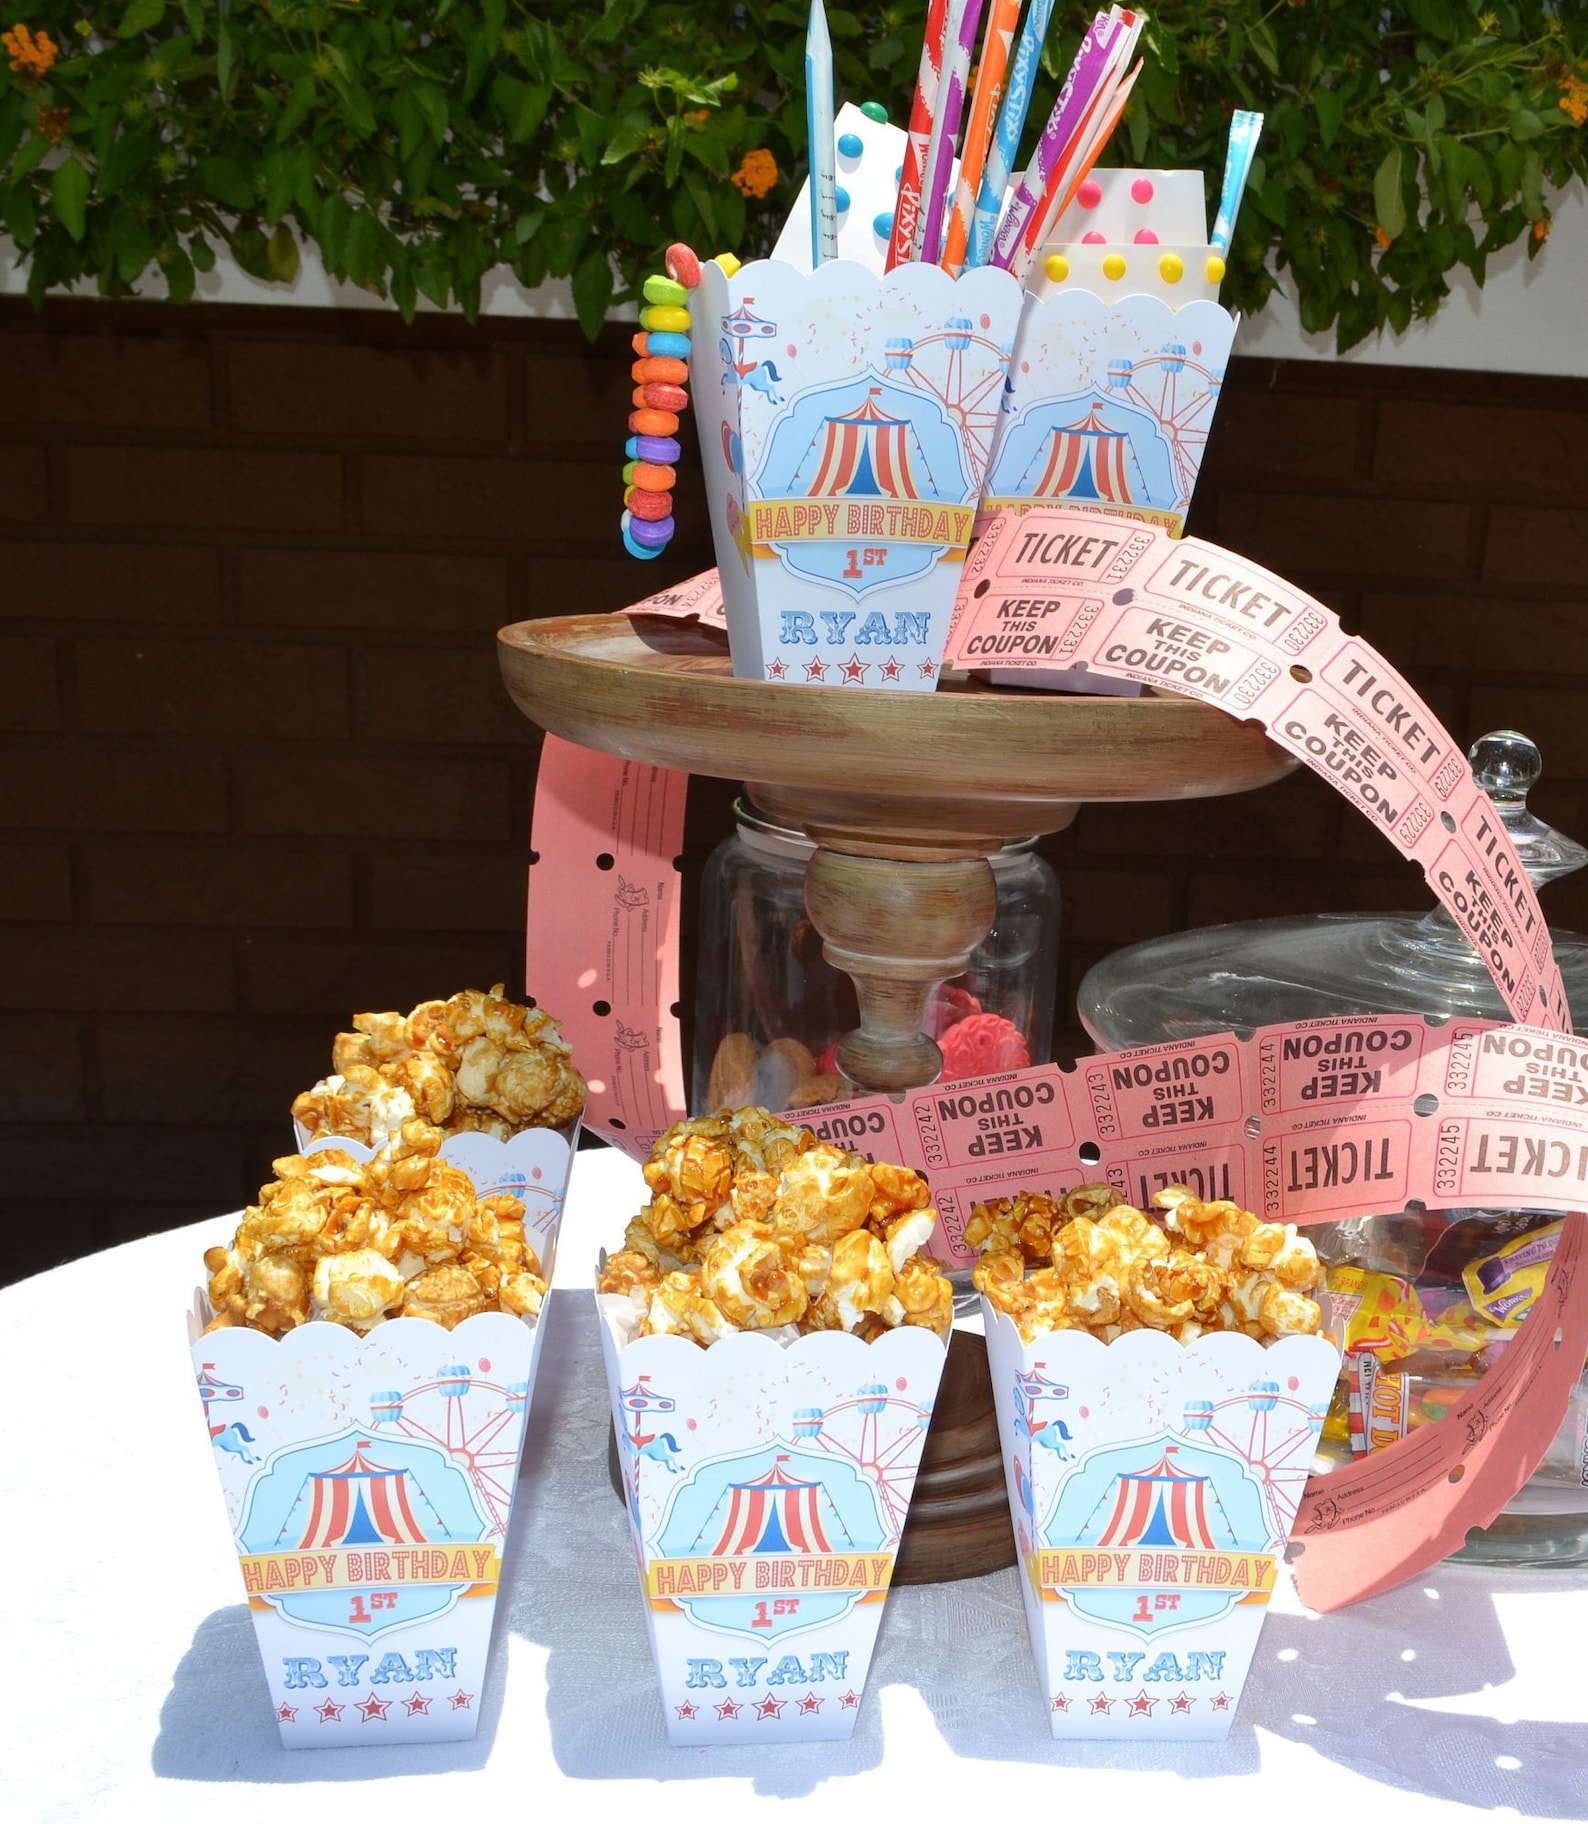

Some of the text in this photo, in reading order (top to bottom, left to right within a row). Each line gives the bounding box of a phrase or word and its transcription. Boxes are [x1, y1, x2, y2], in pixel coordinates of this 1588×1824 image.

[755, 504, 839, 539] HAPPY
[847, 504, 970, 541] BIRTHDAY
[842, 548, 888, 578] 1ST
[971, 523, 1003, 573] 332232
[1015, 533, 1119, 569] TICKET
[1106, 536, 1150, 580] 332231
[997, 600, 1061, 618] KEEP
[1169, 559, 1292, 628] TICKET
[779, 610, 931, 645] RYAN
[1002, 621, 1037, 632] THIS
[1059, 605, 1099, 654] 332231
[1146, 618, 1231, 654] KEEP
[1284, 612, 1324, 651] 332230
[967, 635, 1059, 654] COUPON
[1154, 640, 1201, 661] THIS
[1105, 644, 1230, 694] COUPON
[1233, 661, 1277, 704] 332230
[1342, 658, 1441, 765] TICKET
[1323, 713, 1398, 781] KEEP
[1332, 737, 1374, 779] THIS
[1284, 721, 1398, 824] COUPON
[1306, 757, 1339, 786] INDIANA
[1339, 786, 1367, 810] TICKET
[1434, 757, 1462, 798] 332229
[1399, 802, 1431, 844] 332229
[1476, 815, 1536, 934] TICKET
[1466, 869, 1513, 949] KEEP
[1472, 895, 1499, 945] THIS
[1439, 871, 1516, 994] COUPON
[1309, 1019, 1340, 1028] TICKET
[1341, 1017, 1378, 1025] INDIANA
[1133, 1046, 1162, 1057] TICKET
[1162, 1040, 1196, 1052] INDIANA
[1283, 1030, 1412, 1061] COUPON
[1483, 1034, 1588, 1072] UPON
[1552, 1033, 1588, 1046] NDIANA
[1112, 1050, 1230, 1090] COUPON
[1261, 1043, 1276, 1108] 332244
[1318, 1056, 1367, 1073] THIS
[1447, 1032, 1473, 1090] 332245
[1526, 1062, 1582, 1083] THIS
[959, 1079, 986, 1089] TICKET
[986, 1072, 1018, 1084] INDIANA
[1153, 1082, 1199, 1101] THIS
[1301, 1070, 1382, 1100] KEEP
[797, 1108, 821, 1118] TICKET
[821, 1104, 851, 1113] INDIANA
[938, 1082, 1055, 1122] COUPON
[1088, 1073, 1116, 1134] 332243
[1142, 1096, 1214, 1128] KEEP
[1503, 1111, 1538, 1121] TICKET
[801, 1112, 885, 1141] COUP
[915, 1104, 943, 1164] 332242
[977, 1112, 1025, 1131] THIS
[1304, 1119, 1332, 1129] TICKET
[1332, 1114, 1367, 1124] INDIANA
[1541, 1116, 1584, 1128] INDIANA
[968, 1124, 1044, 1157] KEEP
[1151, 1146, 1176, 1156] TICKET
[1178, 1141, 1208, 1152] INDIANA
[1436, 1124, 1460, 1189] 332245
[1007, 1167, 1039, 1178] INDIANA
[1287, 1138, 1393, 1192] TICKET
[1470, 1134, 1588, 1182] ICKET
[980, 1172, 1005, 1182] TICKET
[1264, 1145, 1279, 1211] 332244
[938, 1196, 967, 1252] 332242
[1457, 1404, 1473, 1419] Name
[1303, 1489, 1324, 1499] Name
[1337, 1487, 1364, 1500] Address
[1342, 1512, 1364, 1525] Phone
[243, 1550, 491, 1591] HAPPY BIRTHDAY
[657, 1559, 888, 1595] HAPPY BIRTHDAY
[1042, 1553, 1272, 1587] HAPPY BIRTHDAY
[348, 1592, 398, 1623] 1ST
[751, 1599, 800, 1628] 1ST
[1132, 1594, 1181, 1622] 1ST
[282, 1647, 458, 1689] RYAN
[685, 1650, 849, 1689] RYAN
[1063, 1650, 1226, 1682] RYAN
